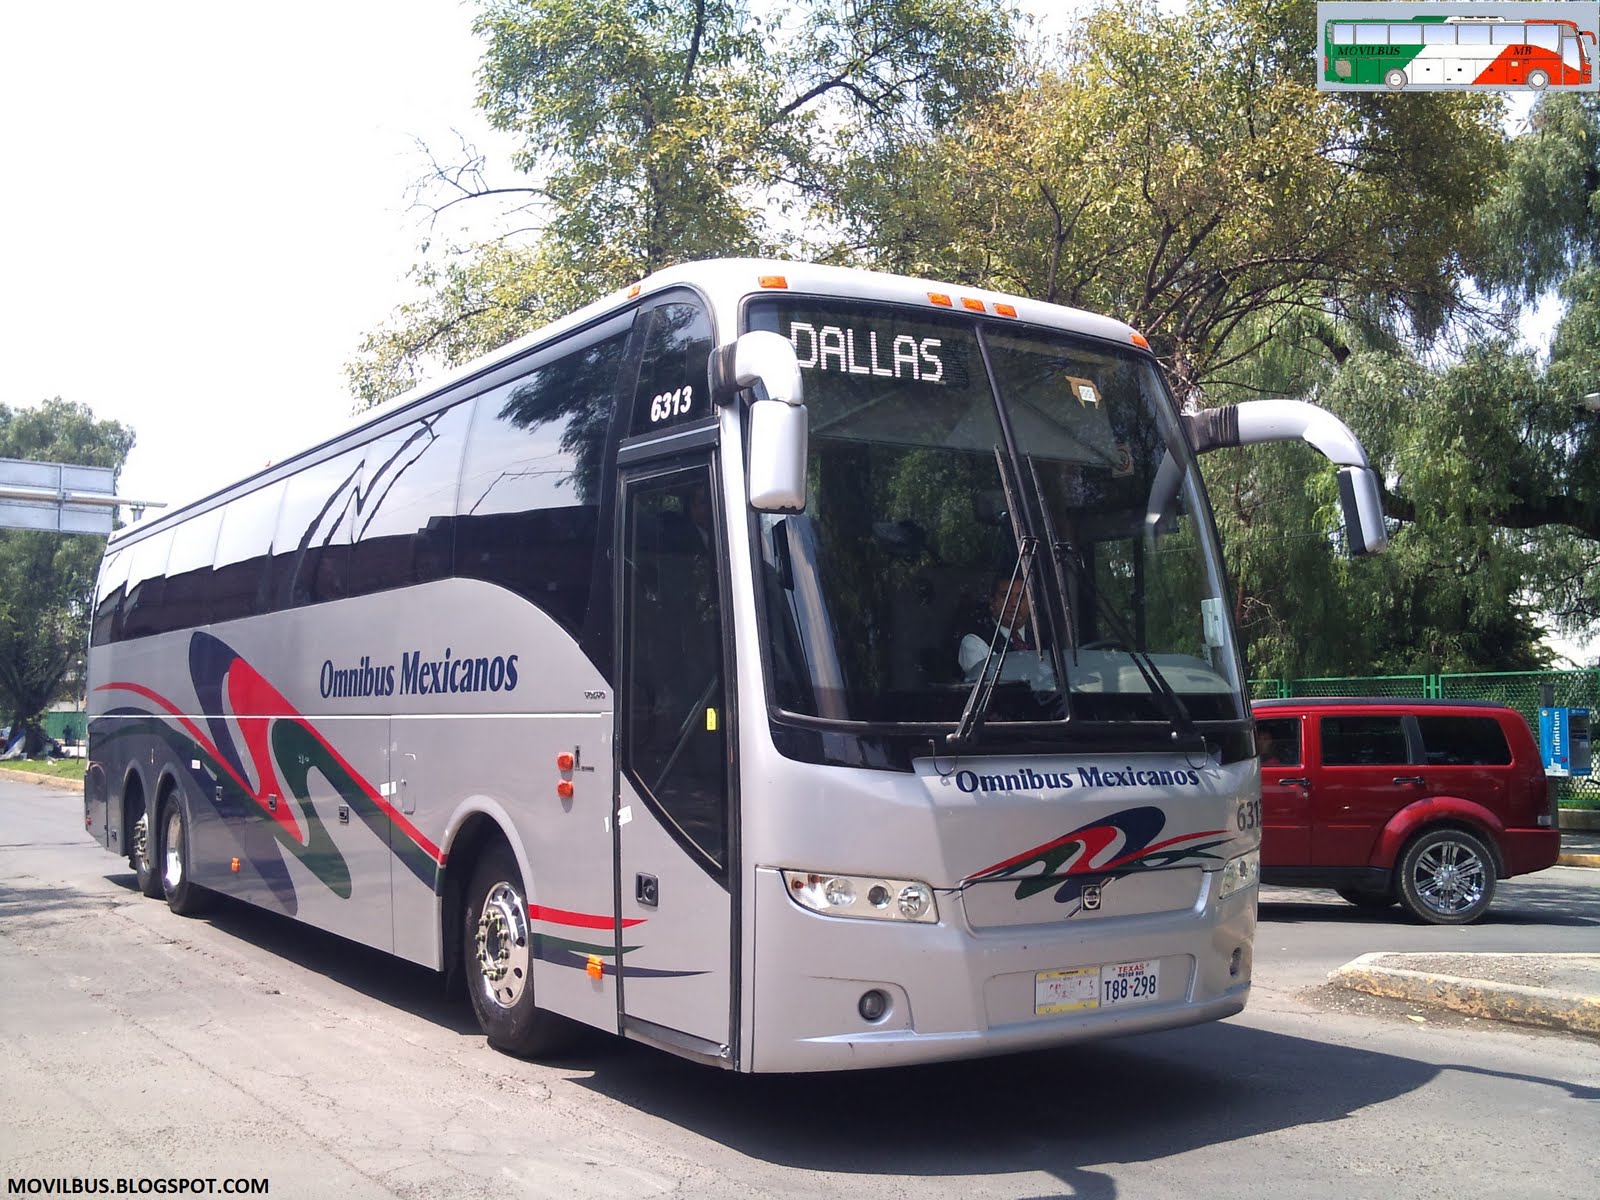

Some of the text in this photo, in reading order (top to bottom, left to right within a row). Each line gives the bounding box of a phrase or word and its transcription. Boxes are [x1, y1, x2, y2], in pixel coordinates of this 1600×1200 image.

[790, 321, 943, 381] DALLAS
[650, 386, 693, 423] 6313
[320, 647, 518, 699] Omnibus Mexicanos
[955, 765, 1199, 793] Omnibus Mexicanos
[1118, 963, 1144, 973] TEXAS
